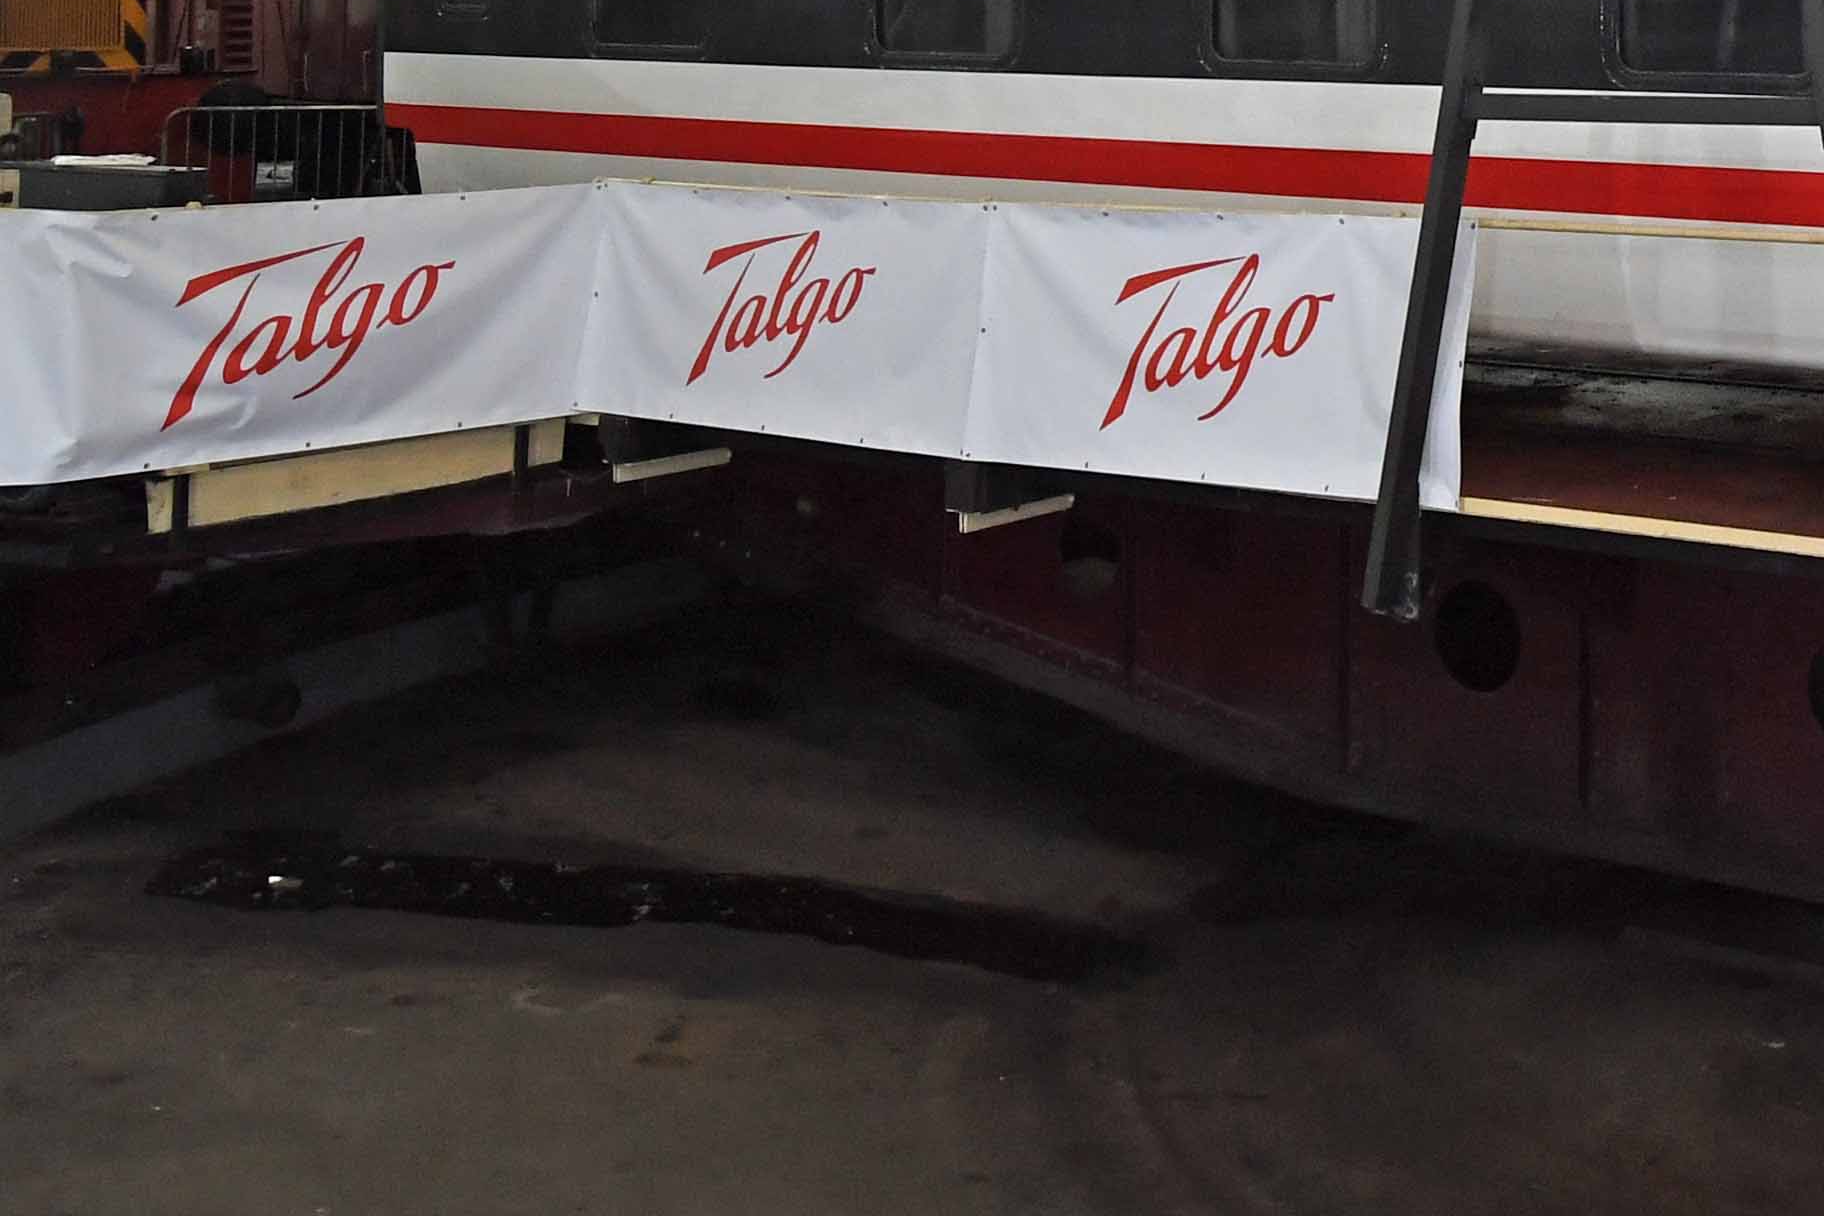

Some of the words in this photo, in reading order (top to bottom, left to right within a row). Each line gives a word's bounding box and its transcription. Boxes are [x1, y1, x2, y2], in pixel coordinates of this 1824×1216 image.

[161, 237, 455, 432] Talgo
[687, 230, 877, 386] Talgo
[1099, 253, 1335, 431] Talgo
